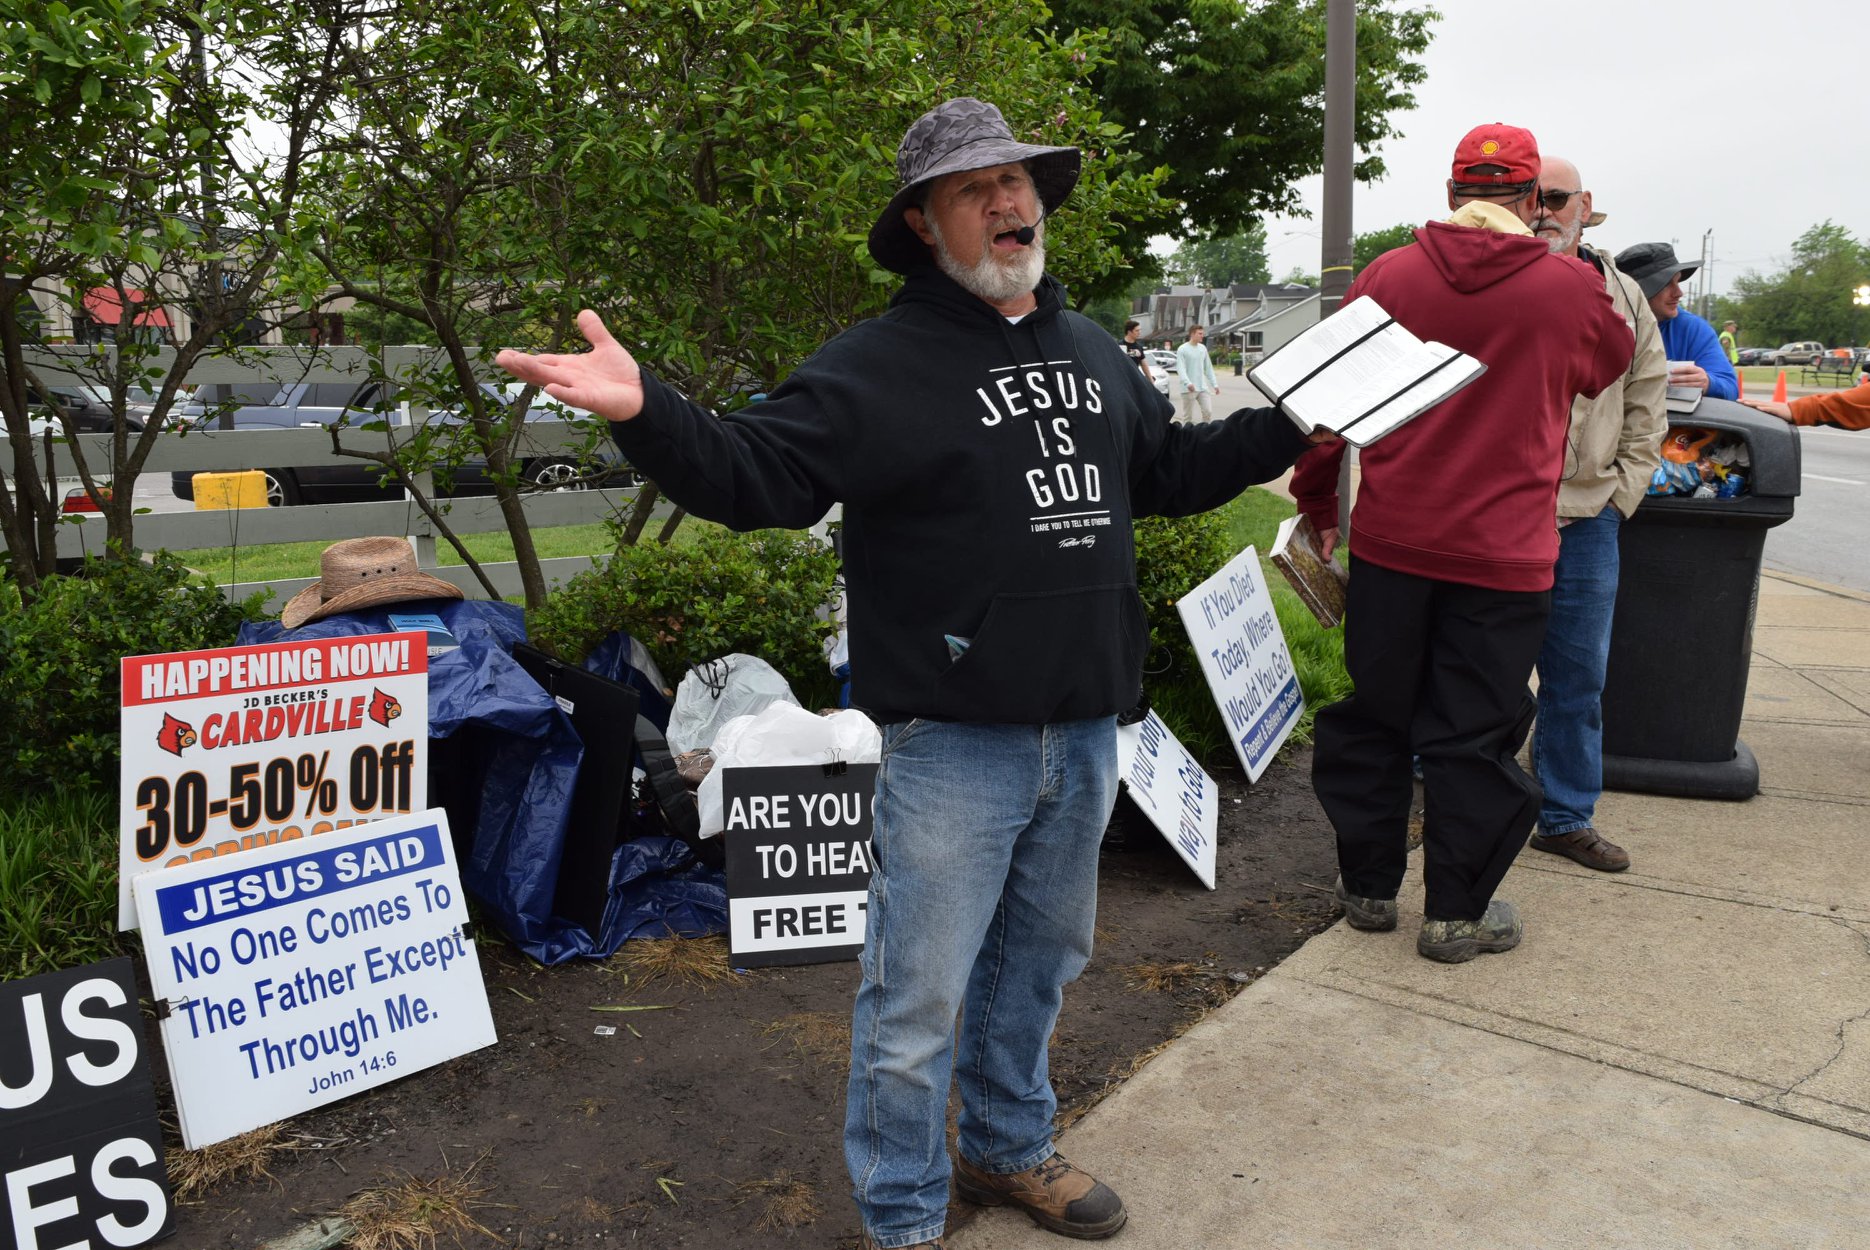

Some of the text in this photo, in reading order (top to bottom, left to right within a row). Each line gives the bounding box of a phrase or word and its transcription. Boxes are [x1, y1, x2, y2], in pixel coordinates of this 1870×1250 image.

[976, 371, 1102, 426] JESUS
[1034, 417, 1075, 458] IS
[1026, 463, 1101, 508] GOD
[1035, 523, 1050, 532] DARE
[1051, 522, 1062, 530] YOU
[1063, 520, 1070, 528] TO
[1071, 520, 1082, 528] TELL
[1200, 565, 1256, 630] If You Died
[141, 640, 410, 699] HAPPENING NOW!
[1212, 610, 1274, 681] Today, Where
[244, 689, 328, 708] JD BECKER'S
[1225, 642, 1292, 732] Would You Go?
[200, 696, 366, 750] CARDVILLE
[1130, 712, 1167, 810] your only
[136, 750, 338, 862] 30-50%
[349, 740, 415, 814] Off
[726, 795, 791, 831] ARE
[798, 792, 861, 827] YOU
[1177, 791, 1202, 822] to
[756, 844, 798, 879] TO
[1178, 809, 1208, 861] way
[183, 861, 323, 922] JESUS
[334, 836, 425, 882] SAID
[171, 878, 452, 984] No One Comes To
[753, 904, 846, 940] FREE
[179, 926, 466, 1039] The Father Except
[239, 994, 438, 1080] Through Me.
[308, 1051, 398, 1095] John 14:6
